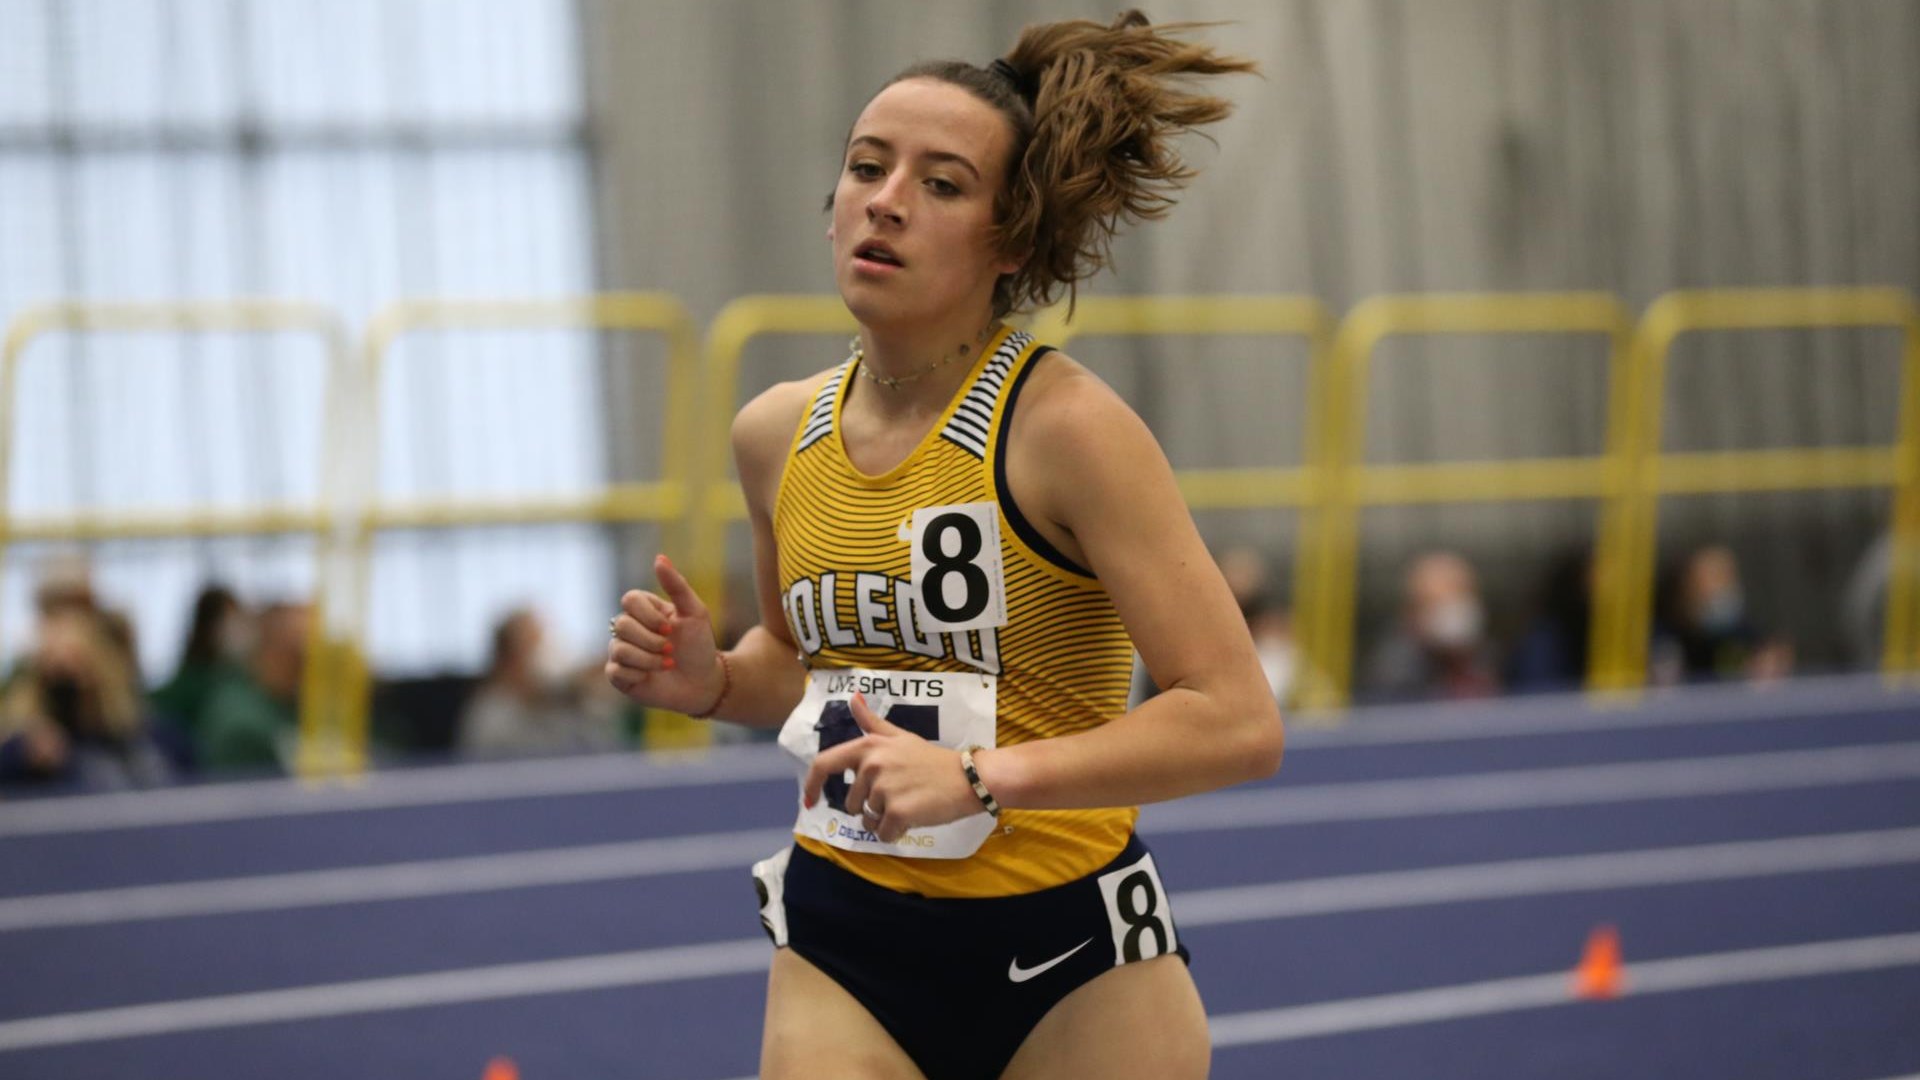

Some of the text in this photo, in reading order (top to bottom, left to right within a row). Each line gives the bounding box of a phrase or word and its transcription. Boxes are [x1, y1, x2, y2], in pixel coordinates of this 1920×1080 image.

[922, 512, 989, 623] 8
[859, 676, 944, 697] SPLITS
[1115, 870, 1168, 963] 8
